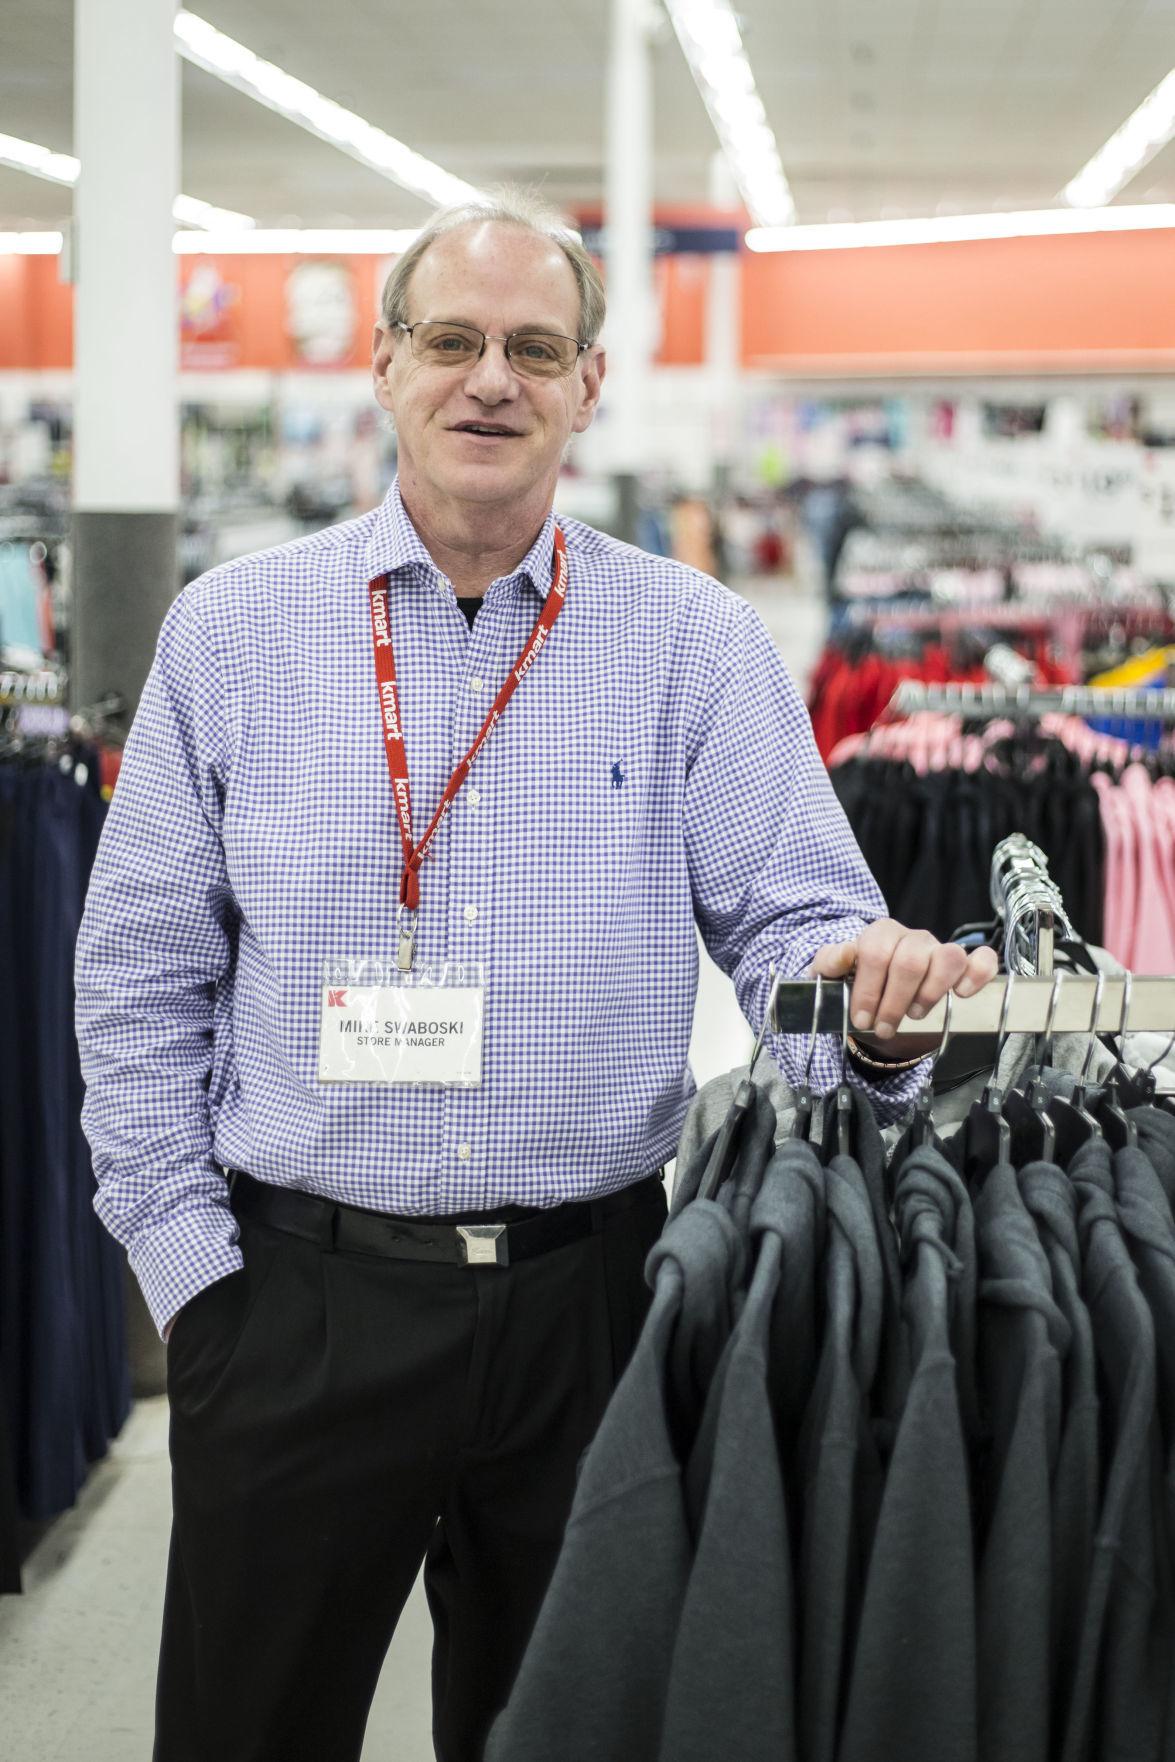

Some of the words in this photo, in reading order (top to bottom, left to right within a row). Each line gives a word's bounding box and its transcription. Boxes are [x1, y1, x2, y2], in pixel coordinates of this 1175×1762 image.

[371, 589, 392, 647] kmart
[514, 624, 549, 682] kmart
[381, 681, 403, 741] kmart
